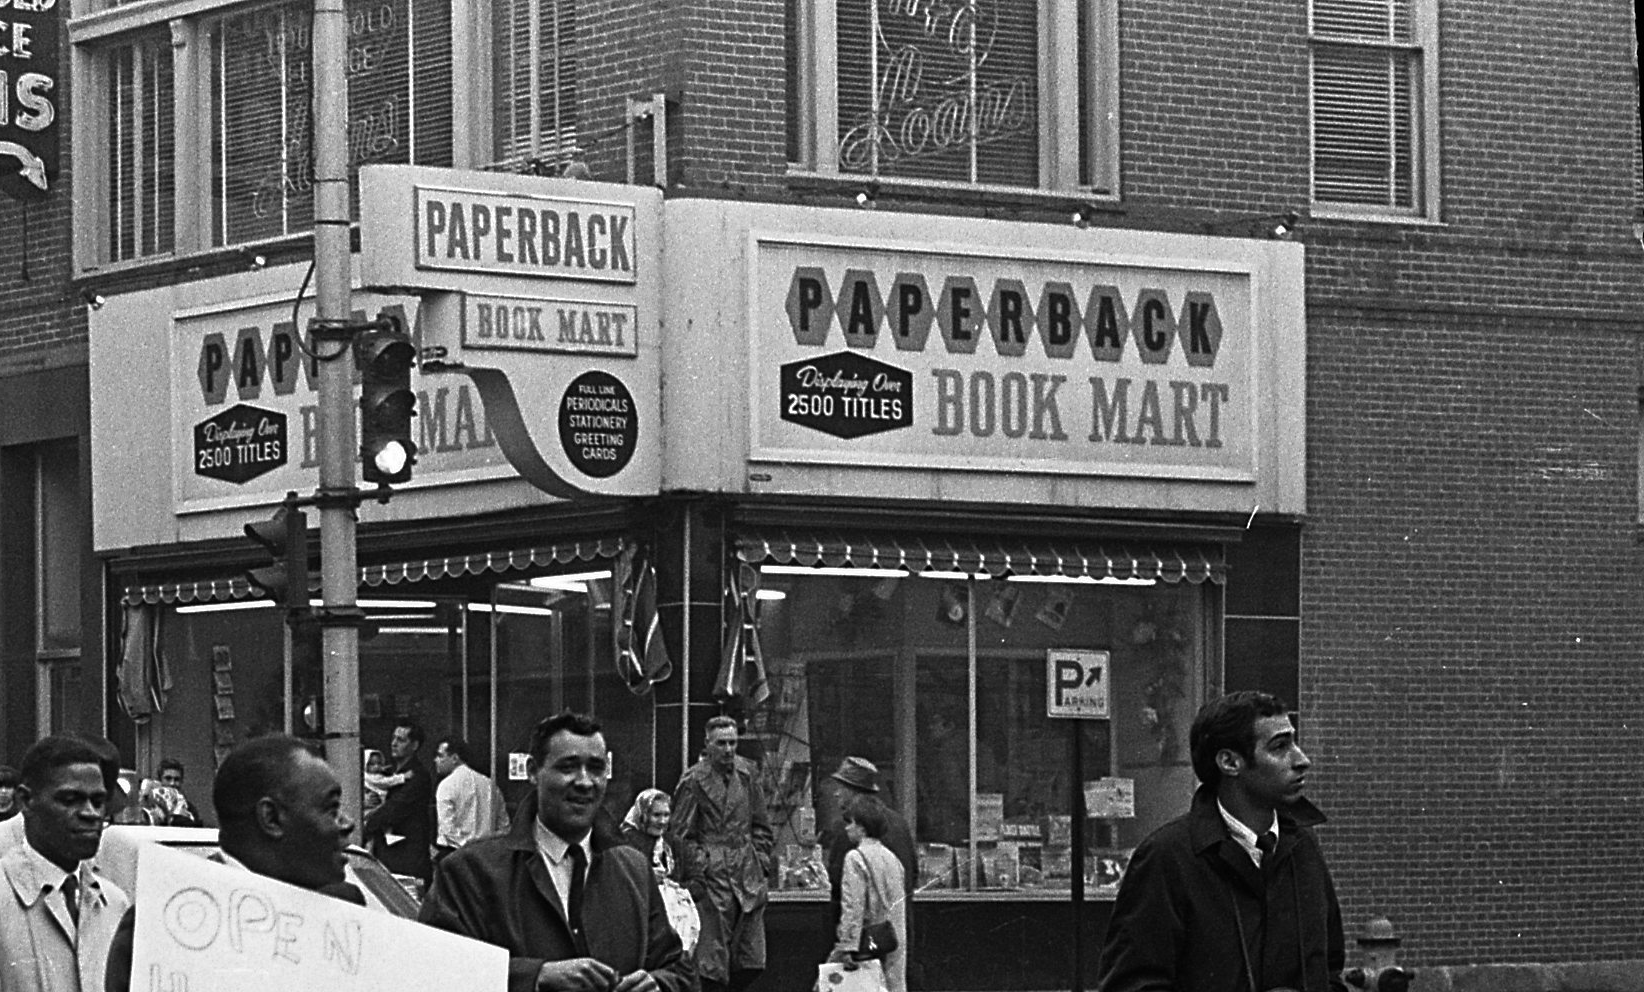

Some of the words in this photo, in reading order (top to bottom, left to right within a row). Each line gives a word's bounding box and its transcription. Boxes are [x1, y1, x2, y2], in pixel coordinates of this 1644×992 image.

[426, 200, 631, 271] PAPERBACK
[556, 308, 627, 346] MART
[797, 276, 1213, 355] PAPERBACK
[579, 384, 597, 395] FULL
[598, 385, 615, 395] LINE
[796, 365, 868, 397] Displaying
[873, 373, 902, 392] Over
[566, 396, 628, 412] PERIODICALS
[788, 394, 833, 416] 2500
[842, 397, 903, 419] TITLES
[932, 368, 1068, 441] BOOK
[1088, 376, 1229, 448] MART
[416, 384, 496, 456] MA
[569, 415, 627, 429] STATIONERY
[574, 432, 624, 446] GREETING
[582, 447, 617, 460] CARDS
[199, 446, 232, 469] 2500
[237, 440, 281, 464] TITLES
[163, 887, 362, 975] OPEN
